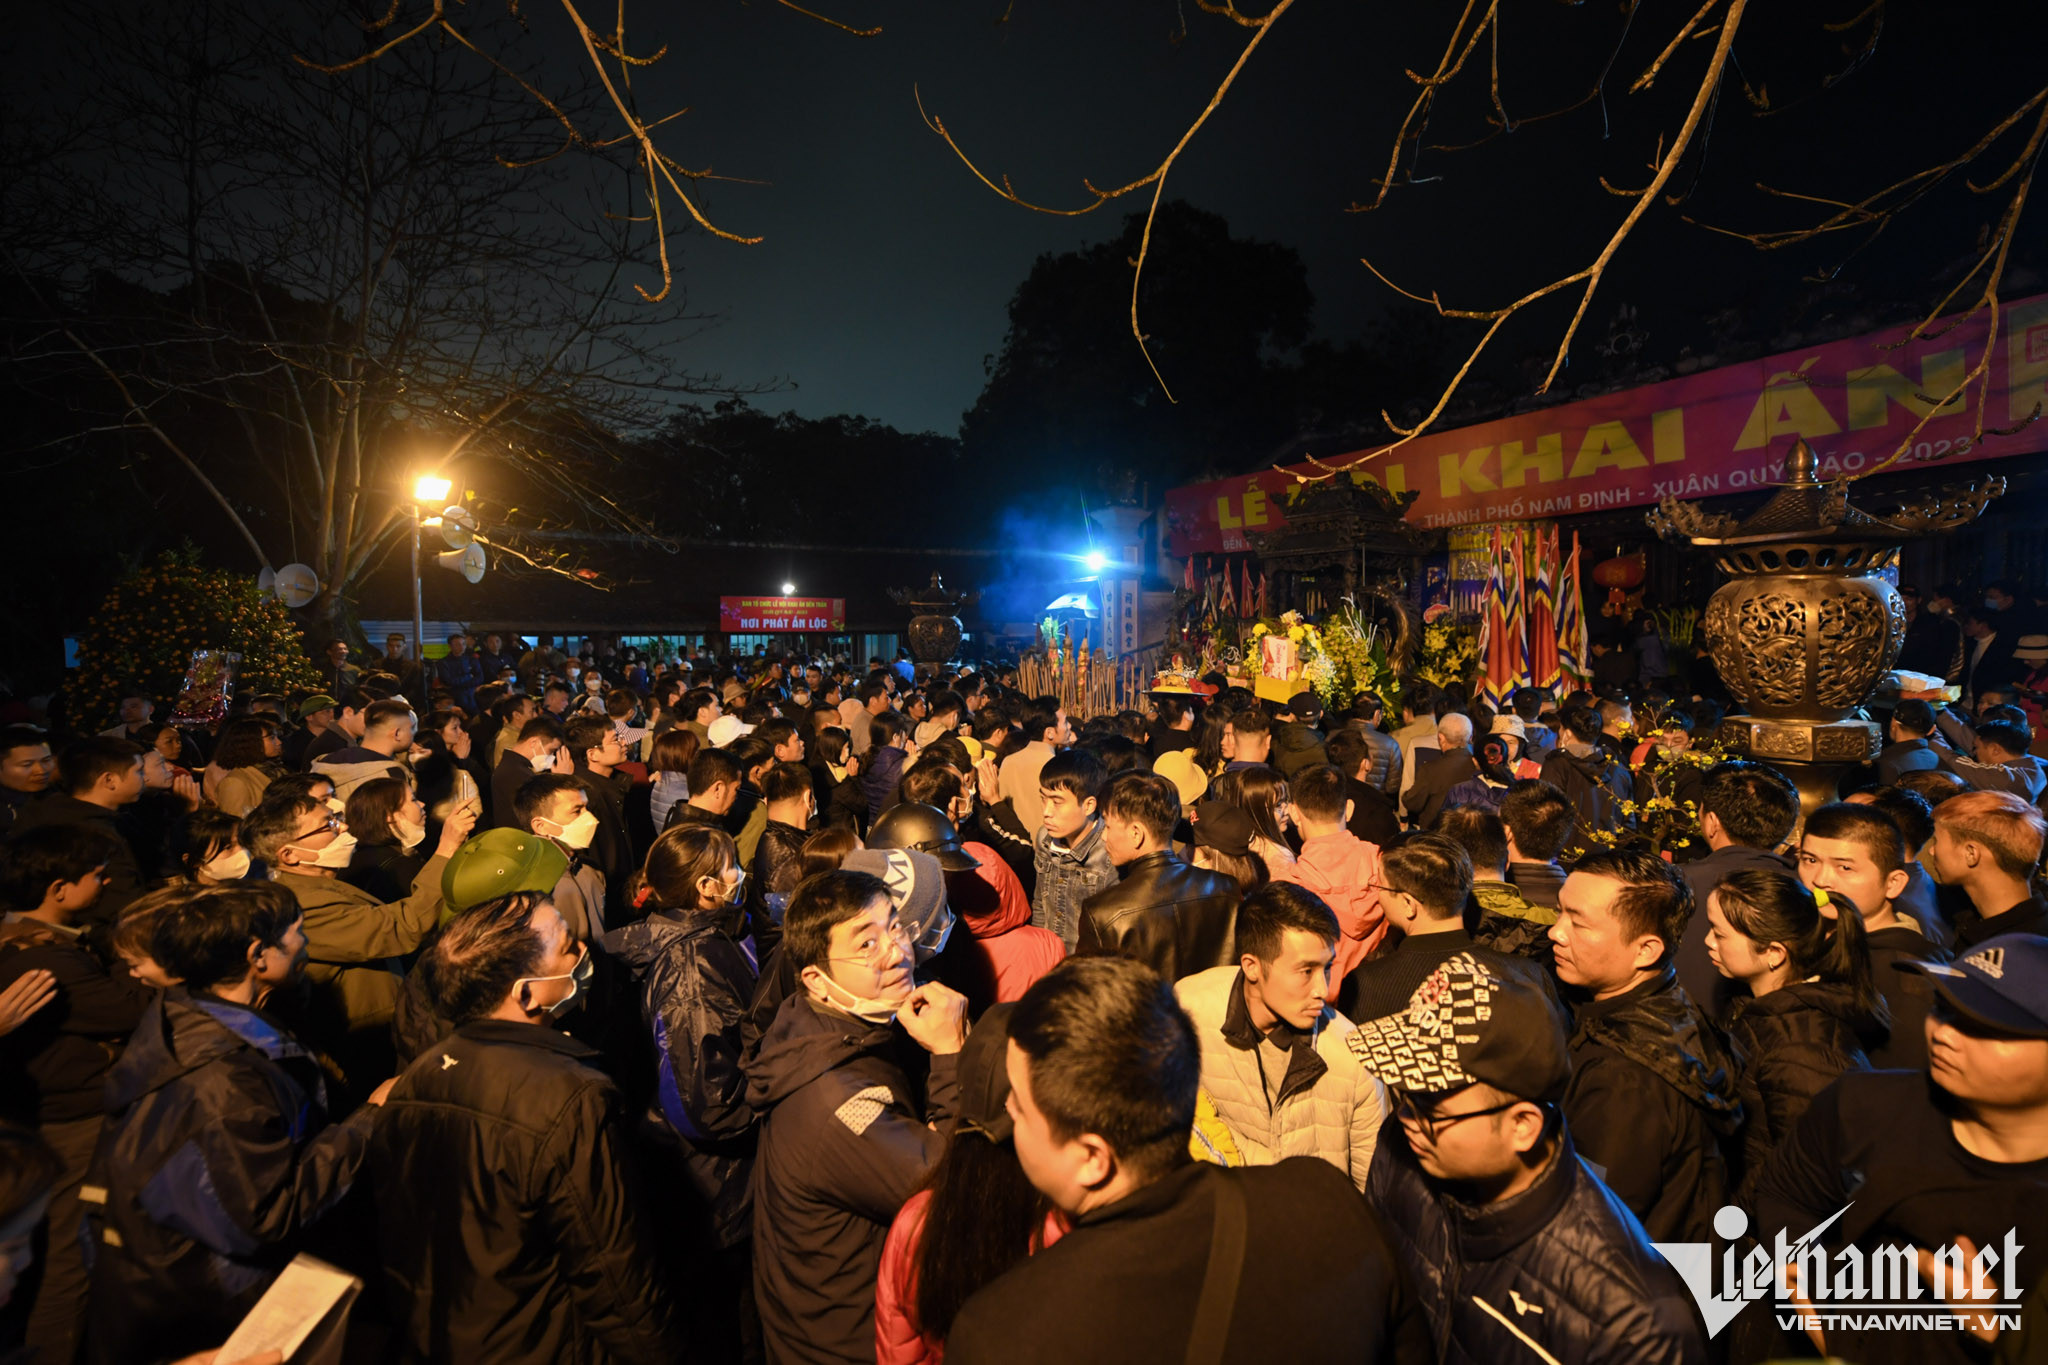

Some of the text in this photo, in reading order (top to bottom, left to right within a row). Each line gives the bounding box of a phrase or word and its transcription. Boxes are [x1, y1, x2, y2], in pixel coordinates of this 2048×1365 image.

[1216, 476, 1268, 530] LỄ
[1438, 408, 1686, 498] KHAI
[1732, 348, 1967, 452] ẤN
[1424, 506, 1481, 527] THÀNH
[1486, 496, 1524, 519] PHỐ
[1529, 496, 1572, 515] NAM
[1579, 487, 1631, 510] ĐỊNH
[1653, 473, 1719, 498] XUÂN
[1728, 458, 1786, 488] QUÝ
[1896, 436, 1973, 464] 2023
[741, 618, 760, 629] NƠI
[763, 616, 789, 629] PHÁT
[809, 617, 828, 630] LỘC
